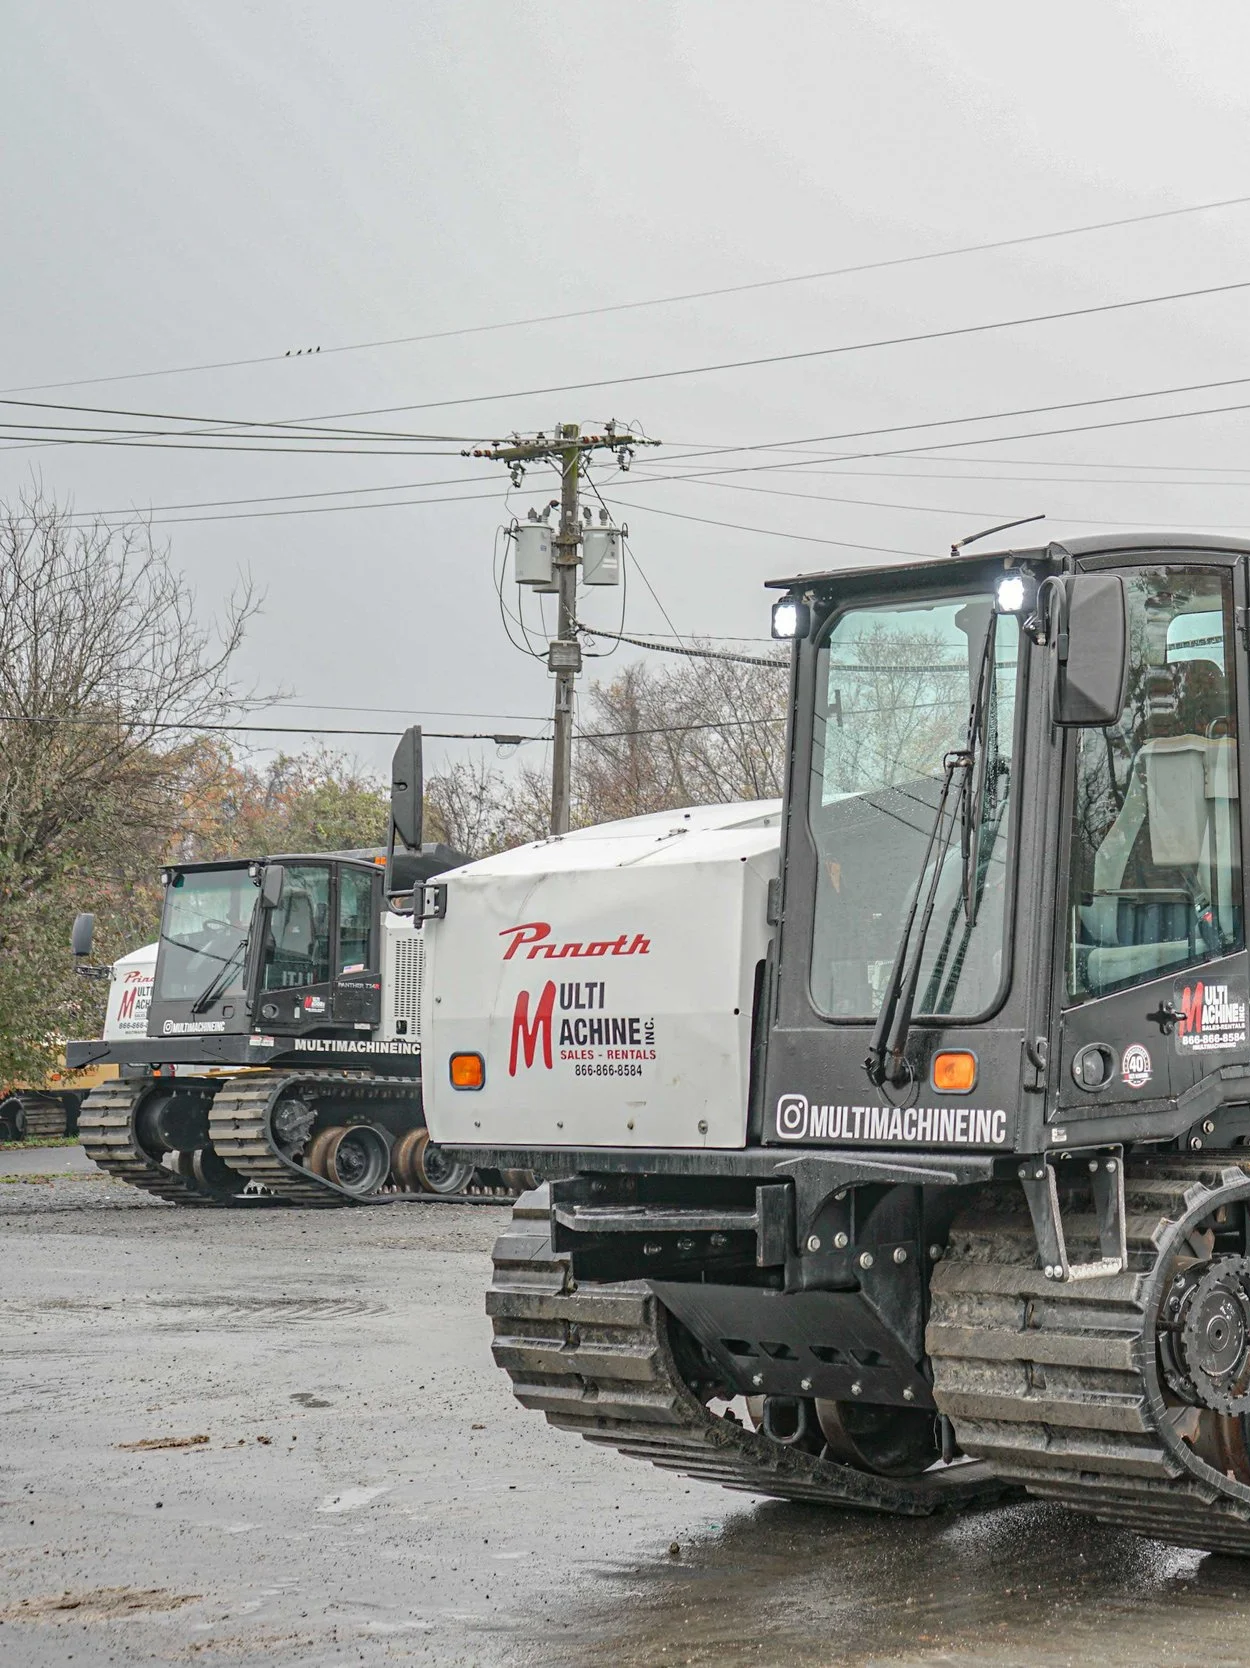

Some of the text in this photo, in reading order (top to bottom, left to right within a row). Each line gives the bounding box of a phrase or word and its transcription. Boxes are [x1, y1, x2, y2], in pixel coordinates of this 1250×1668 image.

[499, 922, 651, 960] Prinoth
[124, 971, 155, 983] Prino
[644, 1017, 655, 1045] INC.
[1182, 1032, 1246, 1045] 866-866-8584
[294, 1039, 420, 1055] MULTIMACHINEINC
[560, 1049, 595, 1061] SALES
[607, 1049, 656, 1060] RENTALS
[1130, 1056, 1144, 1072] 40
[809, 1105, 1006, 1143] MULTIMACHINEINC
